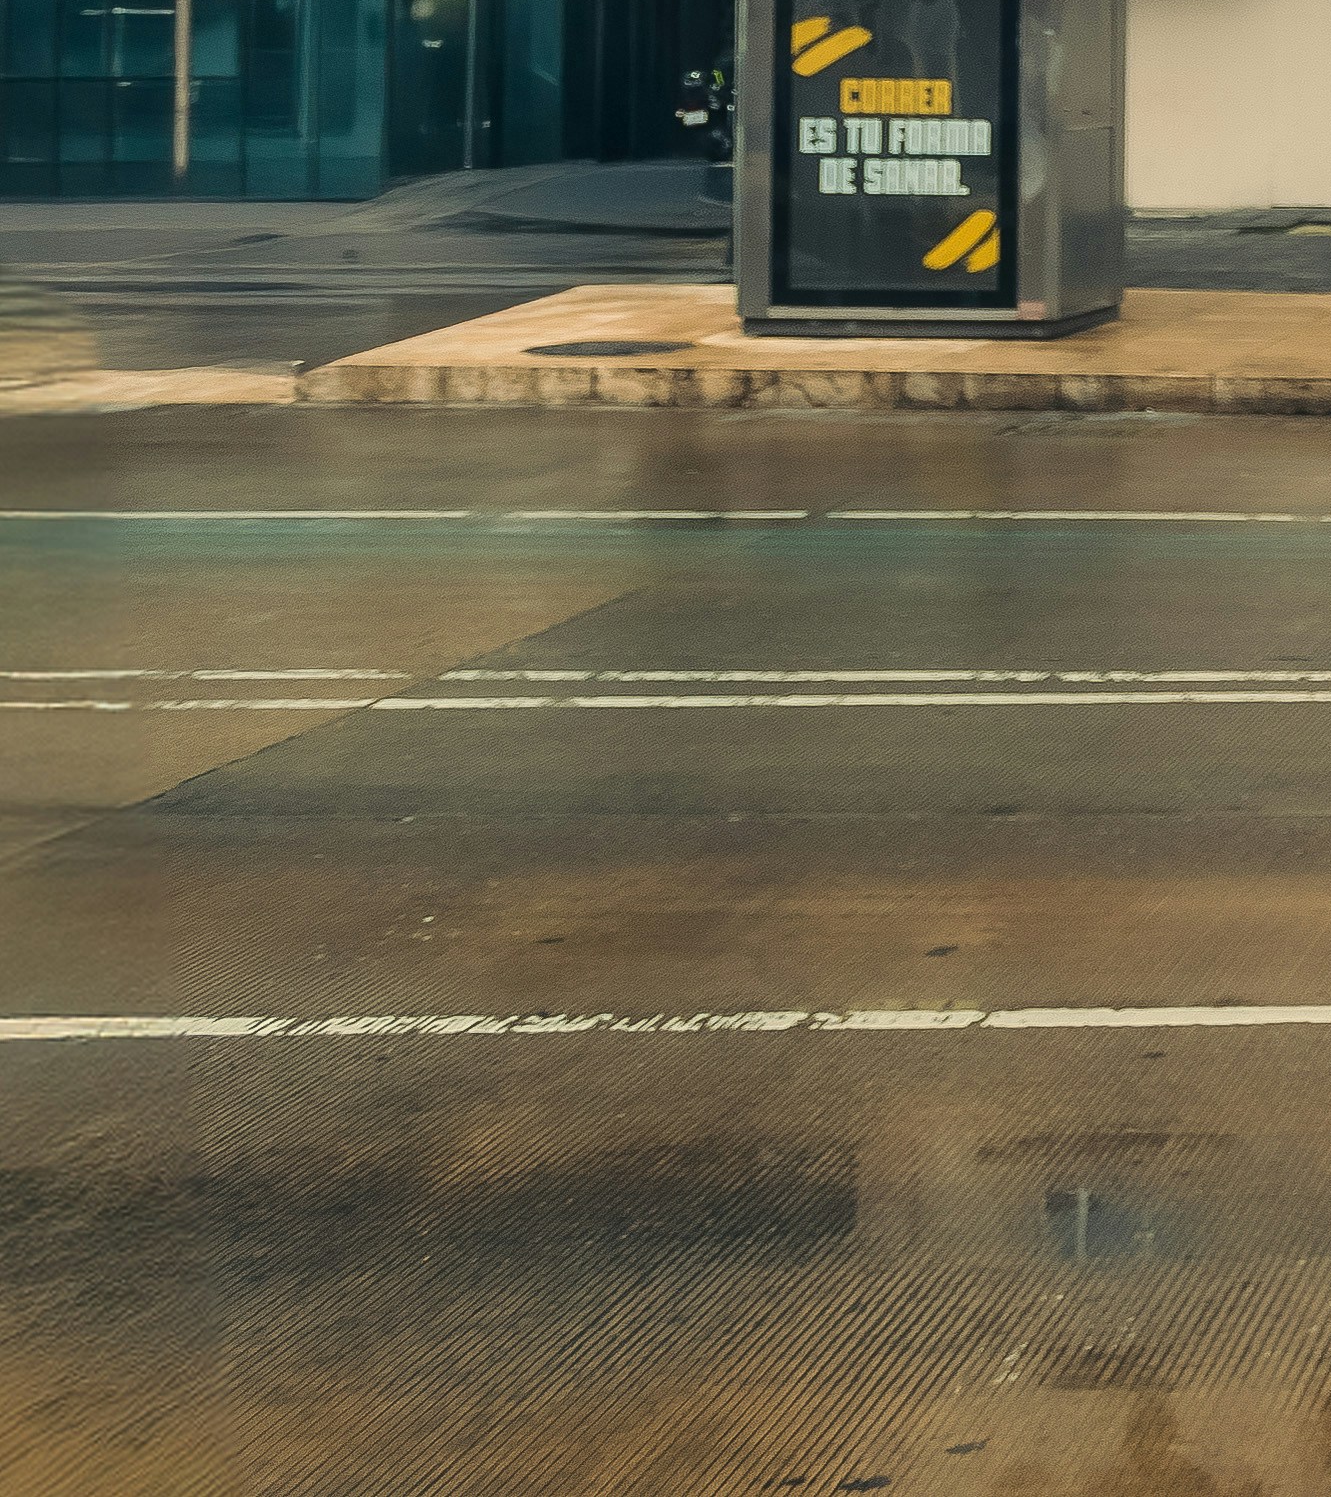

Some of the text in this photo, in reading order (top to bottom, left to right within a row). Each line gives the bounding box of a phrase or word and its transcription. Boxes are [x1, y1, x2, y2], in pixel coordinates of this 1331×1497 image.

[839, 78, 952, 115] CORRER
[799, 116, 992, 156] ES TU FORMA
[819, 158, 858, 195] DE
